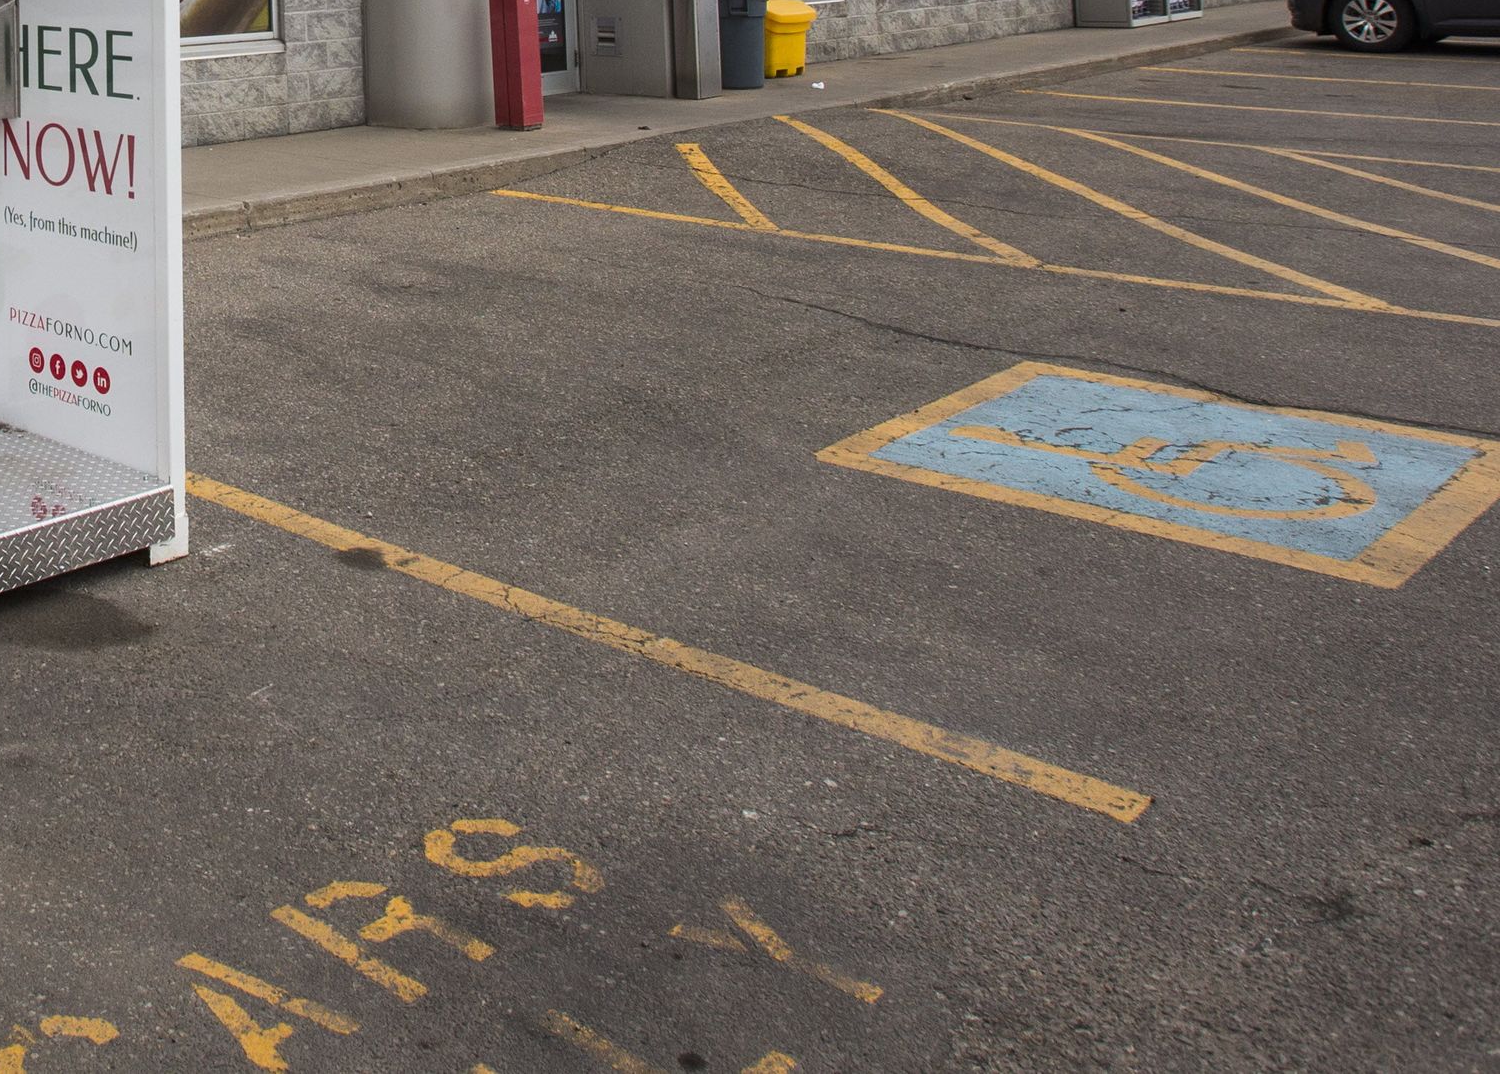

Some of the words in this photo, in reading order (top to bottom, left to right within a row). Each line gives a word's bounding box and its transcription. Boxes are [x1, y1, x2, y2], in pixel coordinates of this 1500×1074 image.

[2, 118, 136, 199] NOW!
[4, 205, 27, 228] (Yes,
[29, 210, 55, 232] from
[58, 217, 77, 238] this
[80, 226, 138, 252] machine!)
[9, 307, 133, 356] PIZZAFORNO.COM
[28, 378, 111, 417] @THEPIZZAFORNO
